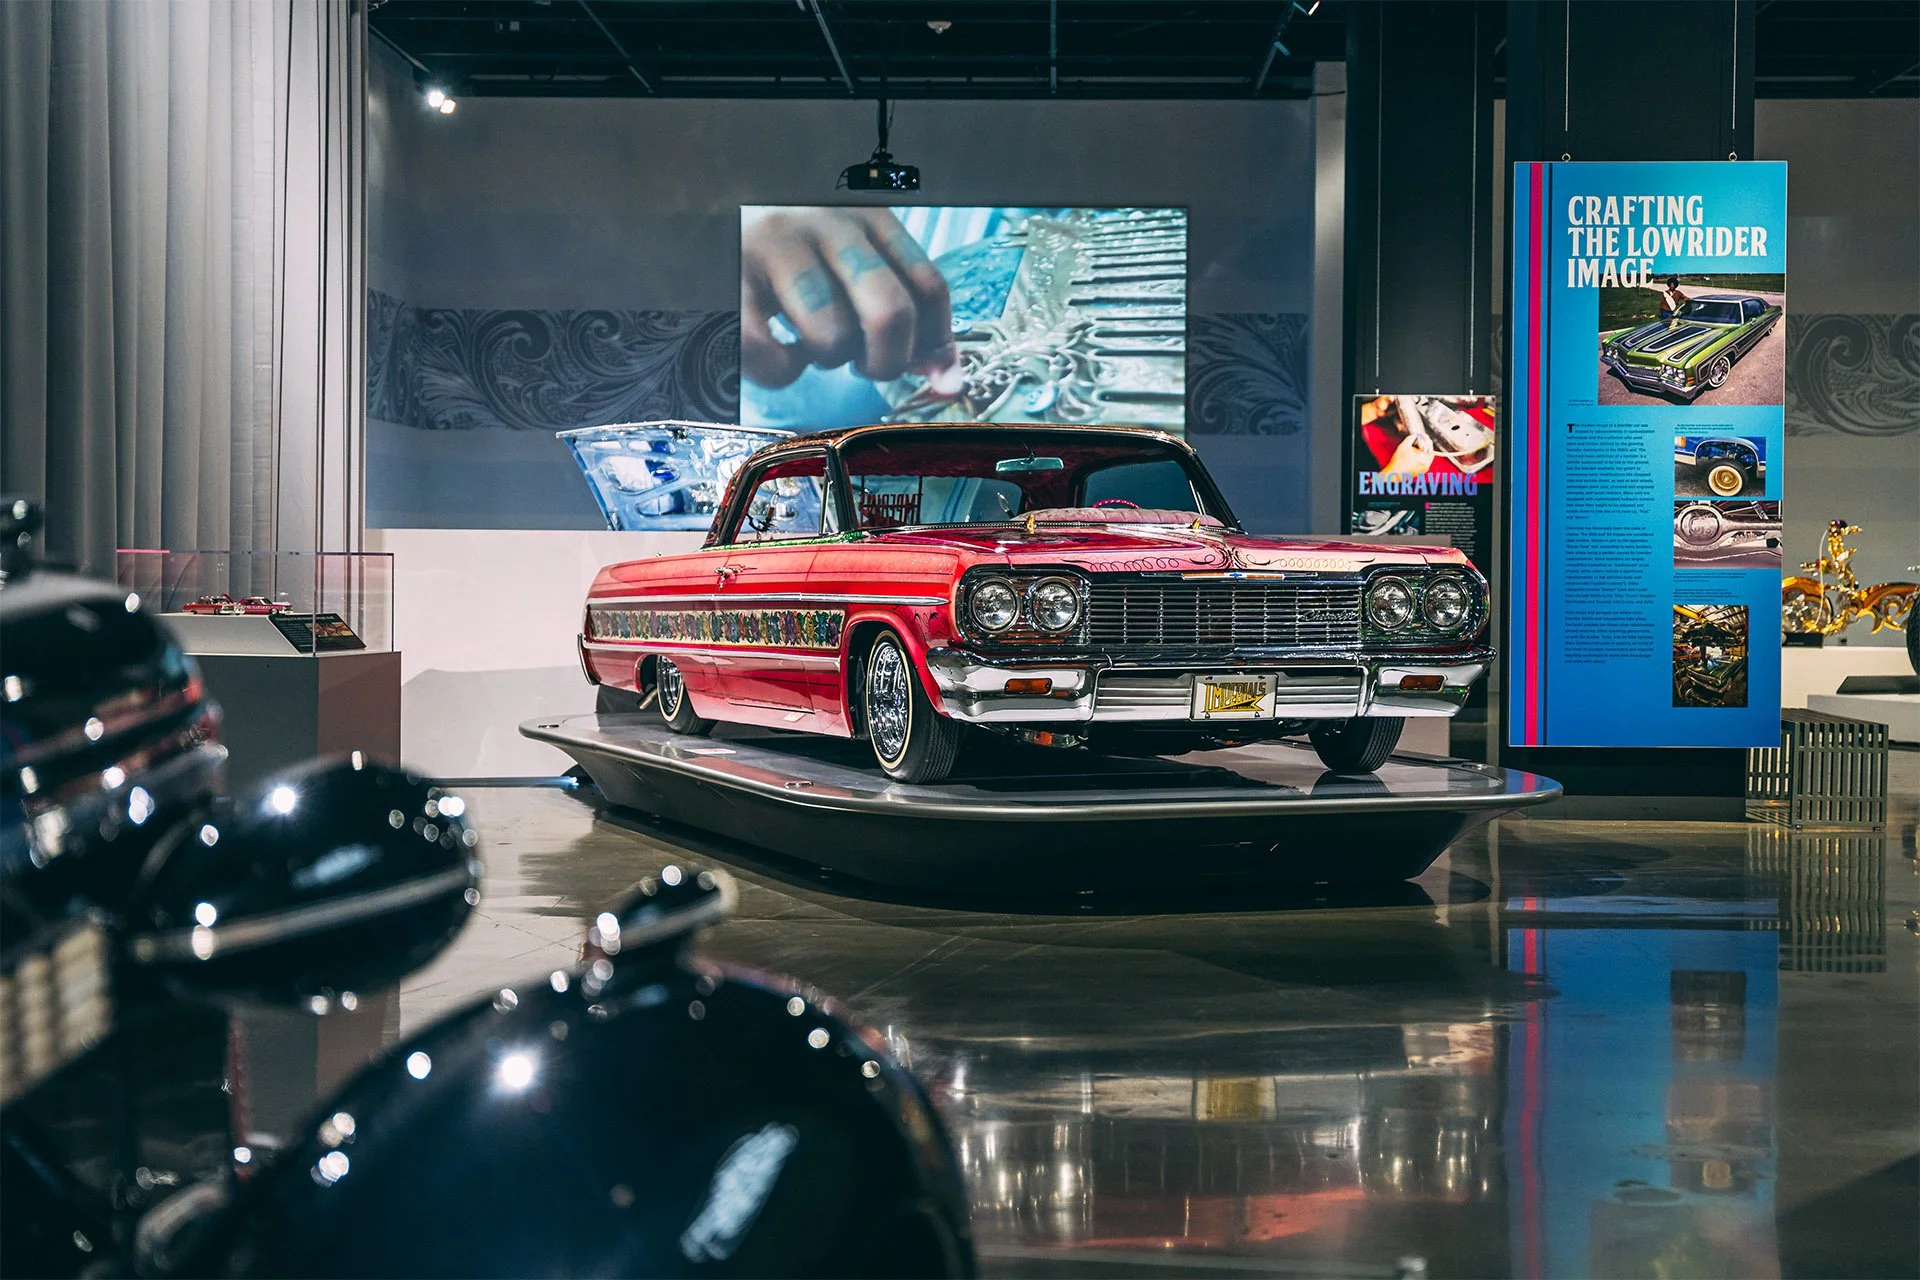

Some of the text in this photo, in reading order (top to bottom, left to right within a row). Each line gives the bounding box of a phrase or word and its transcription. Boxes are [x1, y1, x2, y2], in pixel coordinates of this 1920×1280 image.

[1567, 195, 1703, 226] CRAFTING
[1567, 227, 1768, 257] THE LOWRIDER
[1567, 258, 1654, 288] IMAGE
[1358, 471, 1478, 496] ENGRAVING
